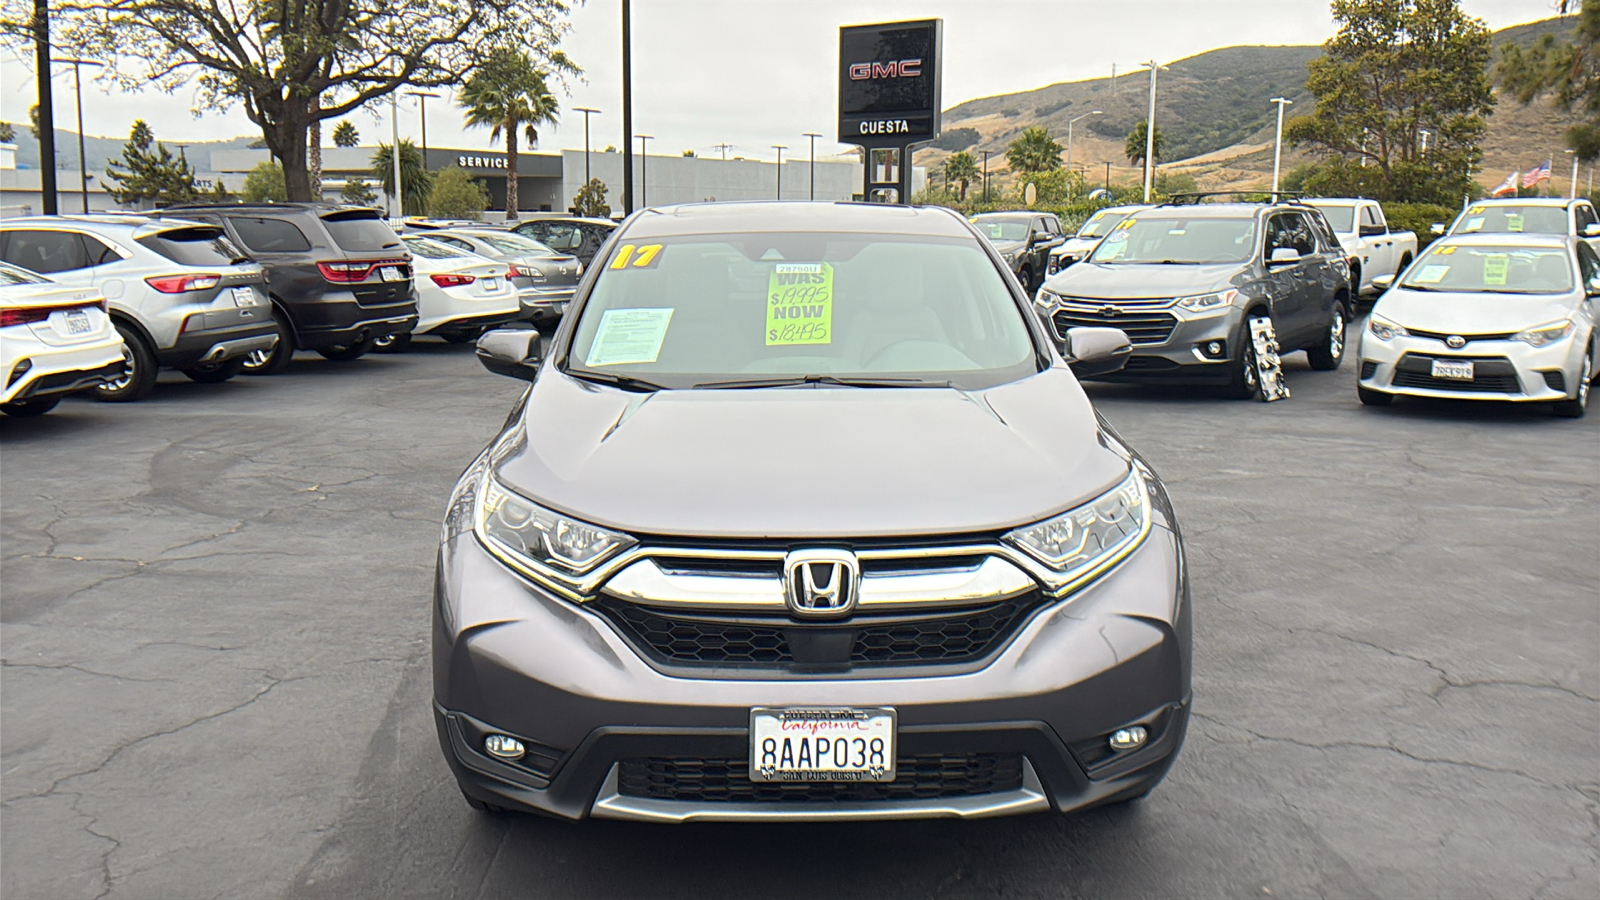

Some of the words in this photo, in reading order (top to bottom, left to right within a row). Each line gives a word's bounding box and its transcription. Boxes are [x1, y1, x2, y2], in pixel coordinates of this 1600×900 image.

[849, 58, 922, 80] GMC
[860, 120, 909, 134] CUESTA
[459, 156, 508, 168] SERVICE
[610, 244, 663, 269] 17
[1432, 246, 1457, 255] 16
[777, 273, 825, 285] WAS
[774, 305, 824, 319] NOW
[782, 719, 869, 735] California
[762, 737, 884, 768] 8AAP038
